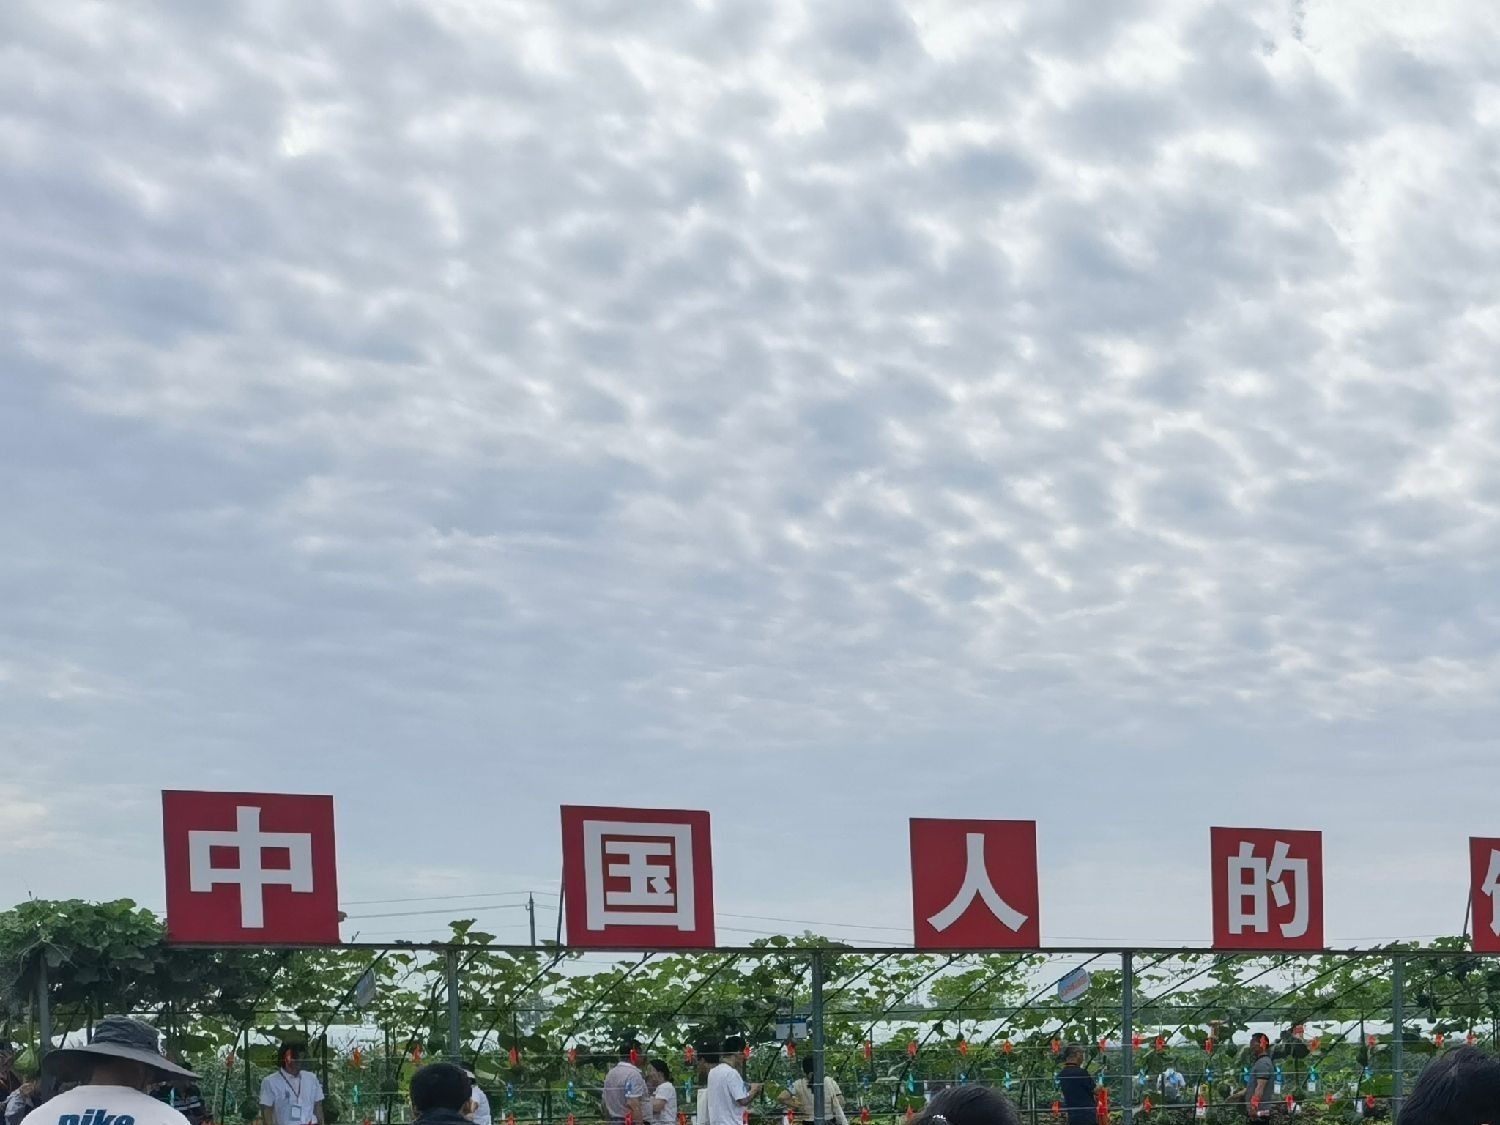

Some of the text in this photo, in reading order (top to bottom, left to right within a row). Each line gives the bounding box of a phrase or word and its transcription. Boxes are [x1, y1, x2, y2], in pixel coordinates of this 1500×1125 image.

[189, 806, 313, 927] 中
[584, 821, 695, 931] 国
[927, 833, 1028, 932] 人
[1228, 842, 1308, 937] 的
